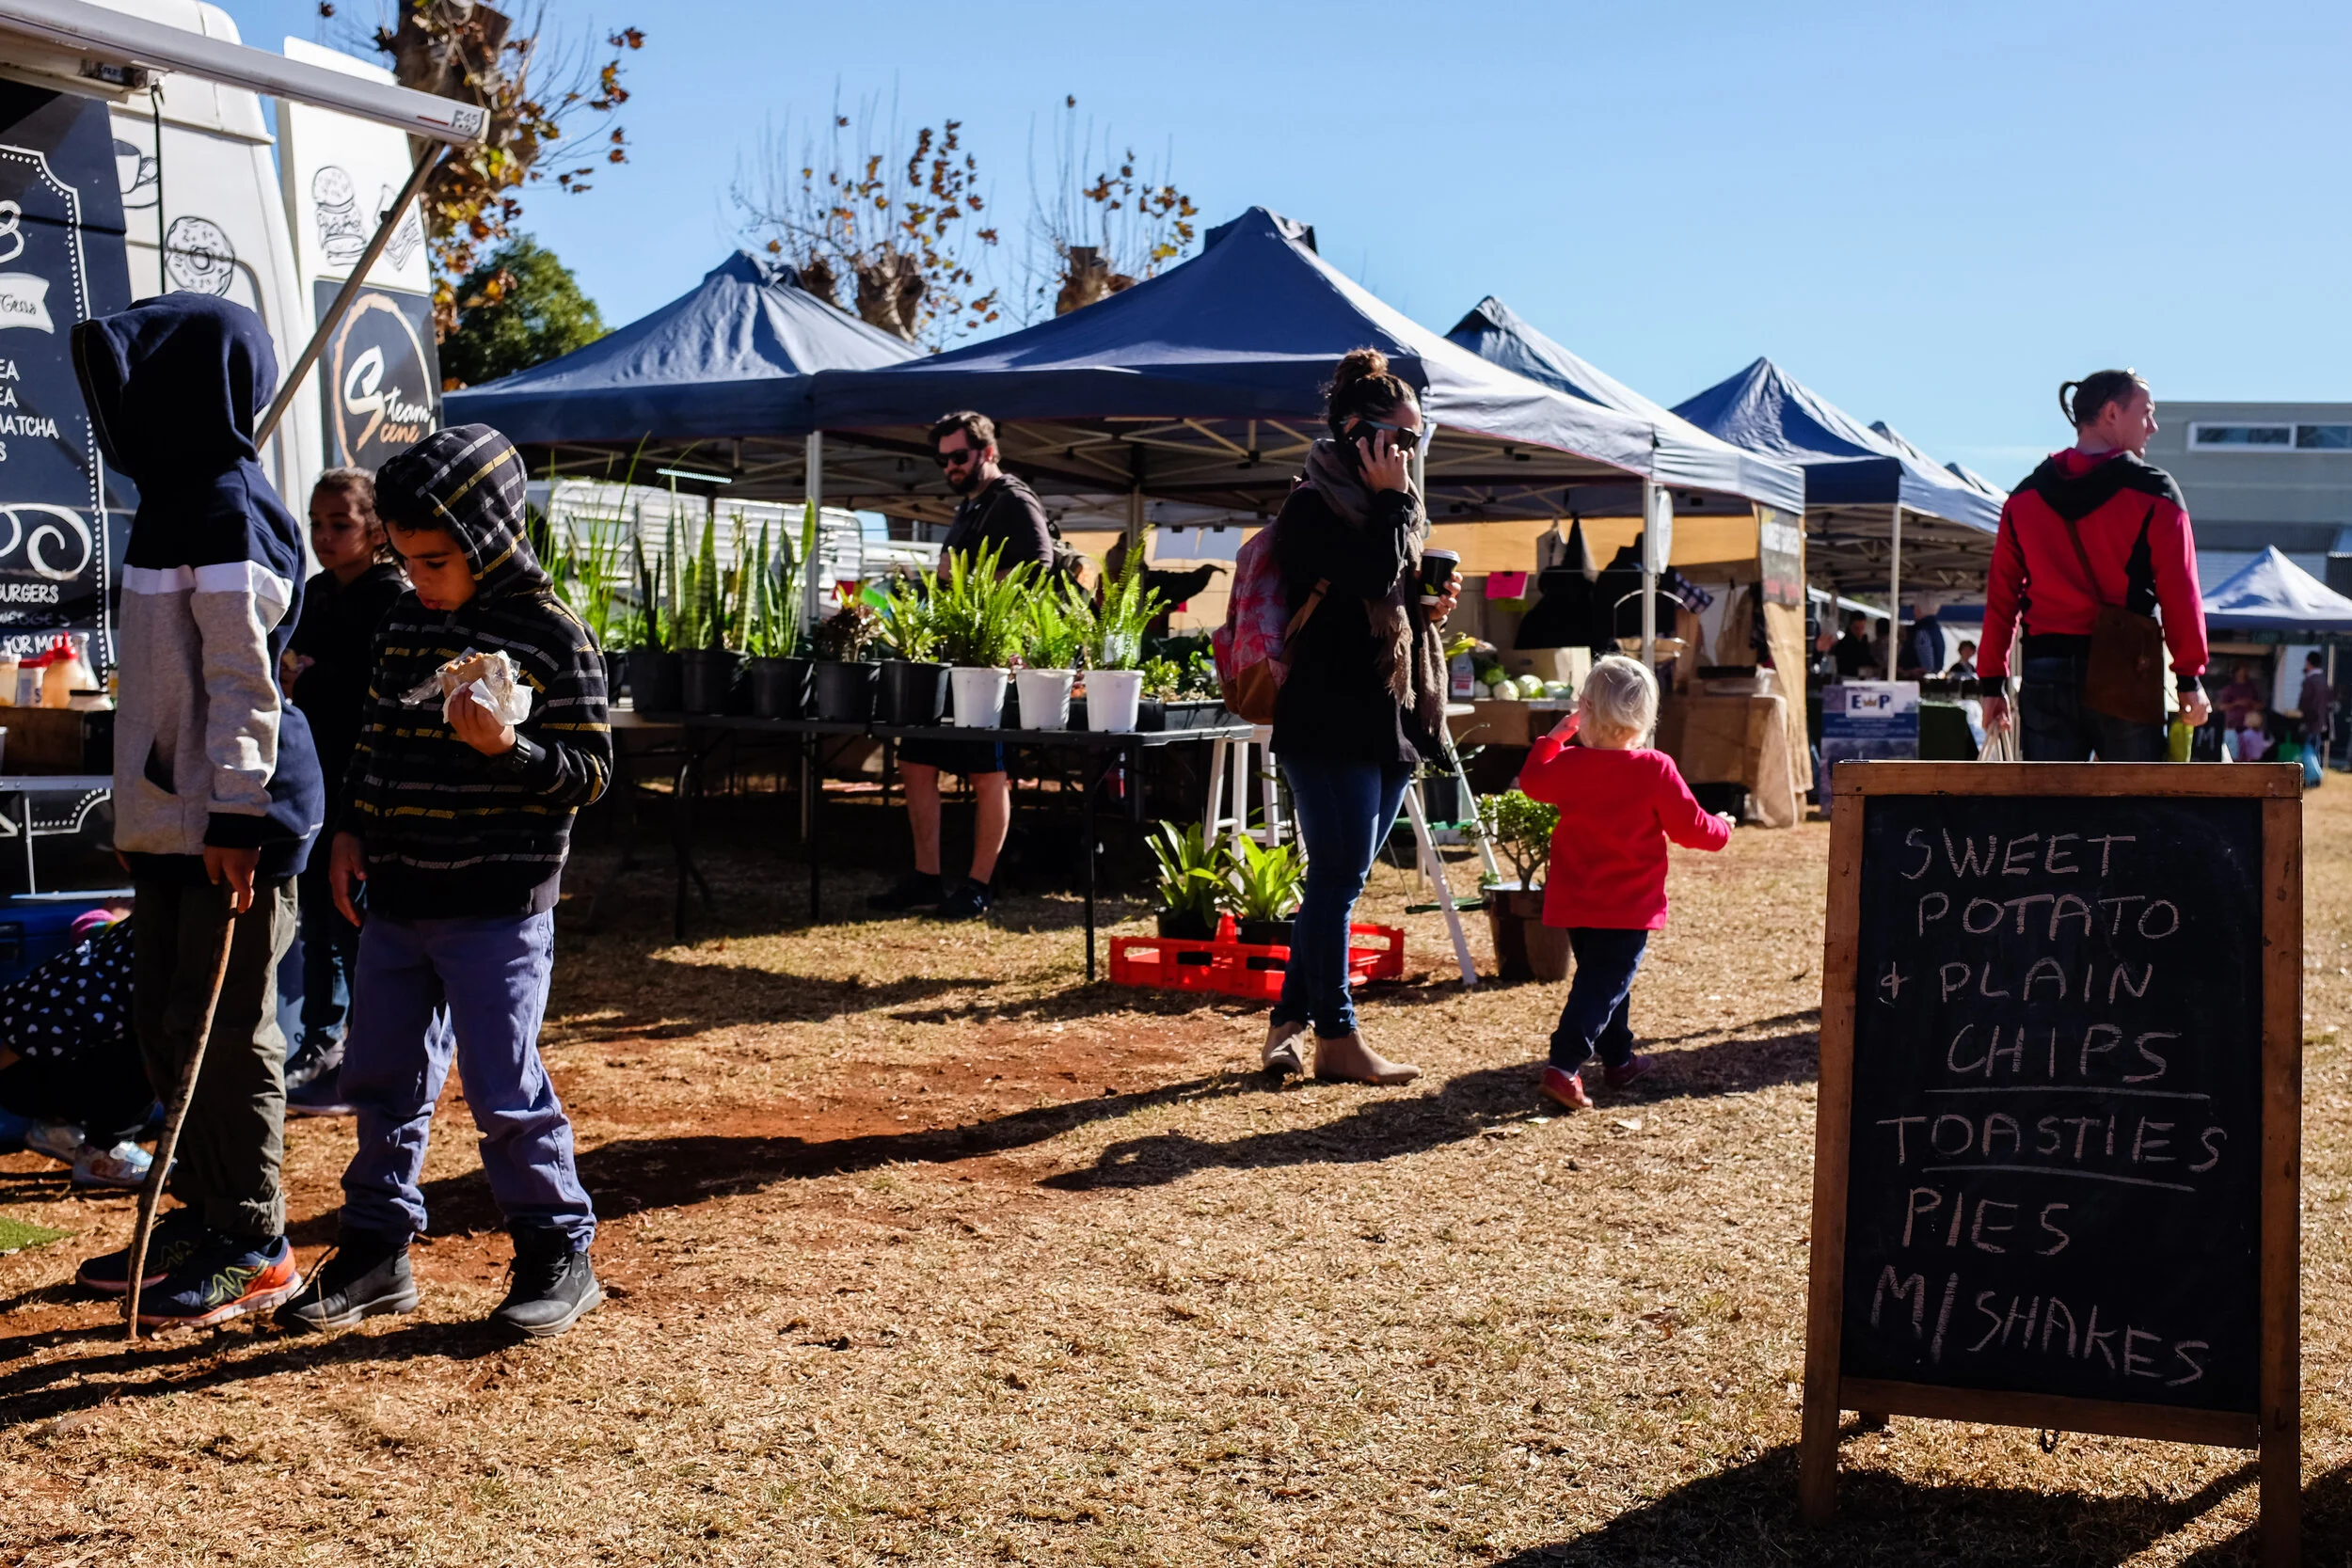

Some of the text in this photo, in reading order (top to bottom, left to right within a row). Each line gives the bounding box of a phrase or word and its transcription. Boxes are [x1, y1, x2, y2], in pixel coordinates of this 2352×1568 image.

[1900, 827, 2137, 879] SWEET
[1917, 892, 2180, 941] POTATO
[1940, 956, 2153, 1005] PLAIN
[1947, 1022, 2182, 1082] CHIPS
[1876, 1113, 2228, 1172] TOASTIES
[1900, 1186, 2070, 1256] PIES
